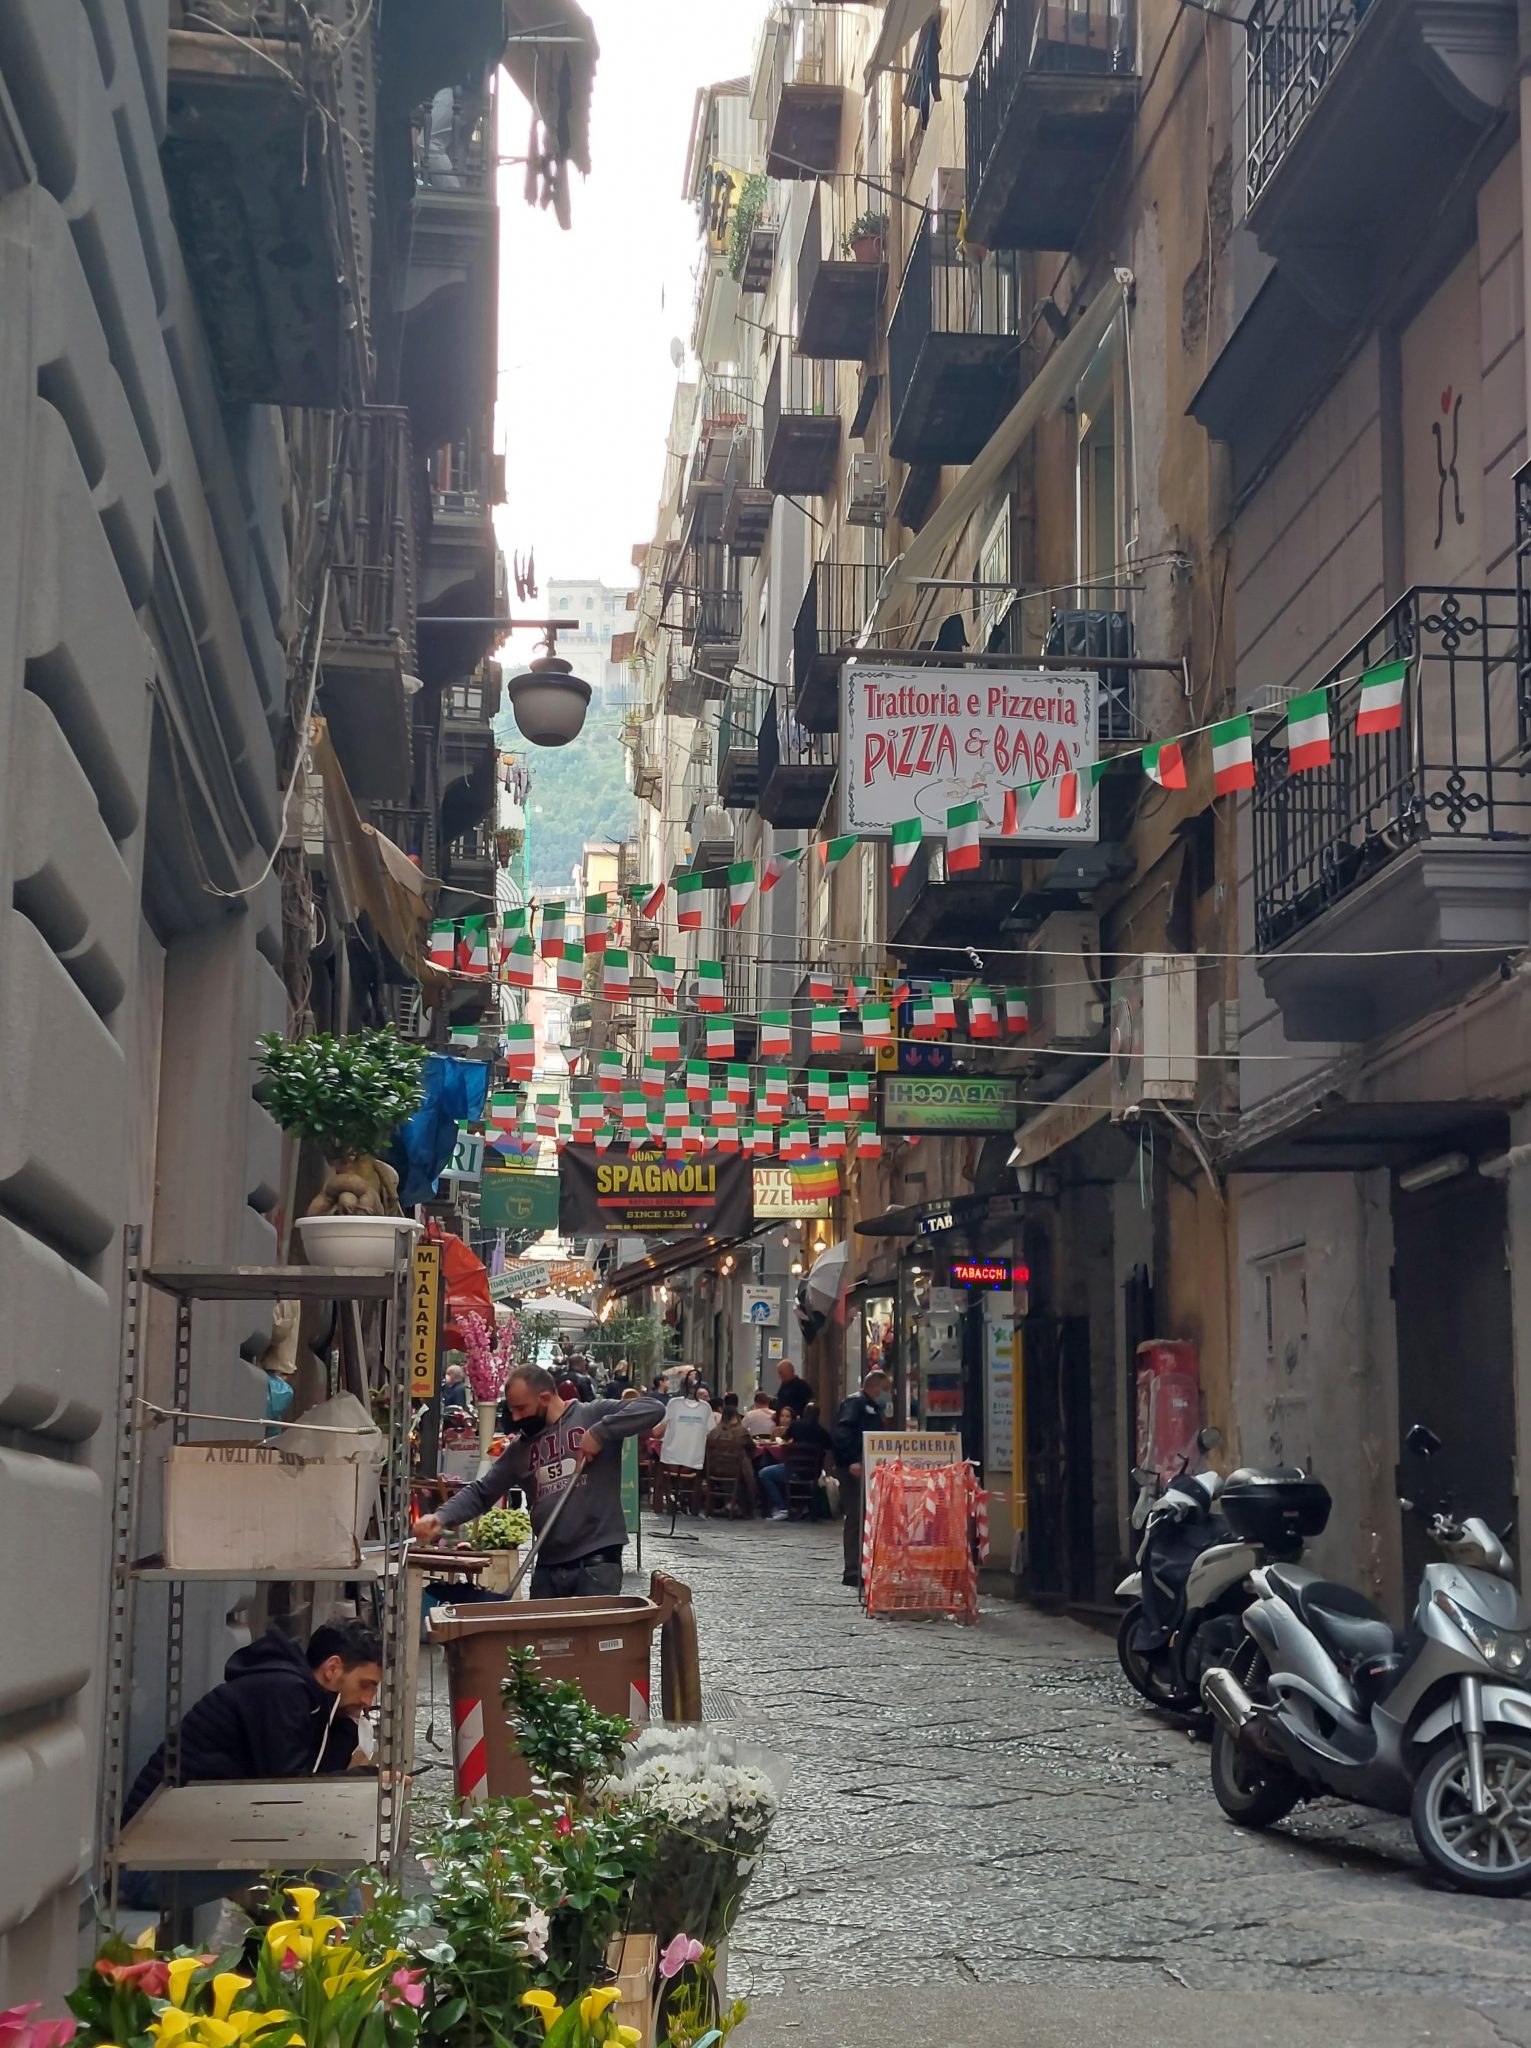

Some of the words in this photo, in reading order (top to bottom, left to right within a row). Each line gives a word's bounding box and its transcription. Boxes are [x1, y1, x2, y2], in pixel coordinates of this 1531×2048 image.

[864, 683, 961, 720] Trattoria
[967, 694, 981, 716] e
[988, 685, 1078, 727] Pizzeria
[964, 727, 990, 758] &
[597, 1164, 716, 1193] SPAGNOLI
[626, 1210, 661, 1219] SINCE
[663, 1210, 687, 1218] 1536
[417, 1252, 436, 1263] M.
[955, 1266, 1007, 1280] TABACCHI
[414, 1270, 431, 1377] TALARICO
[870, 1439, 956, 1452] TABACCHERIA
[547, 1463, 562, 1479] 53
